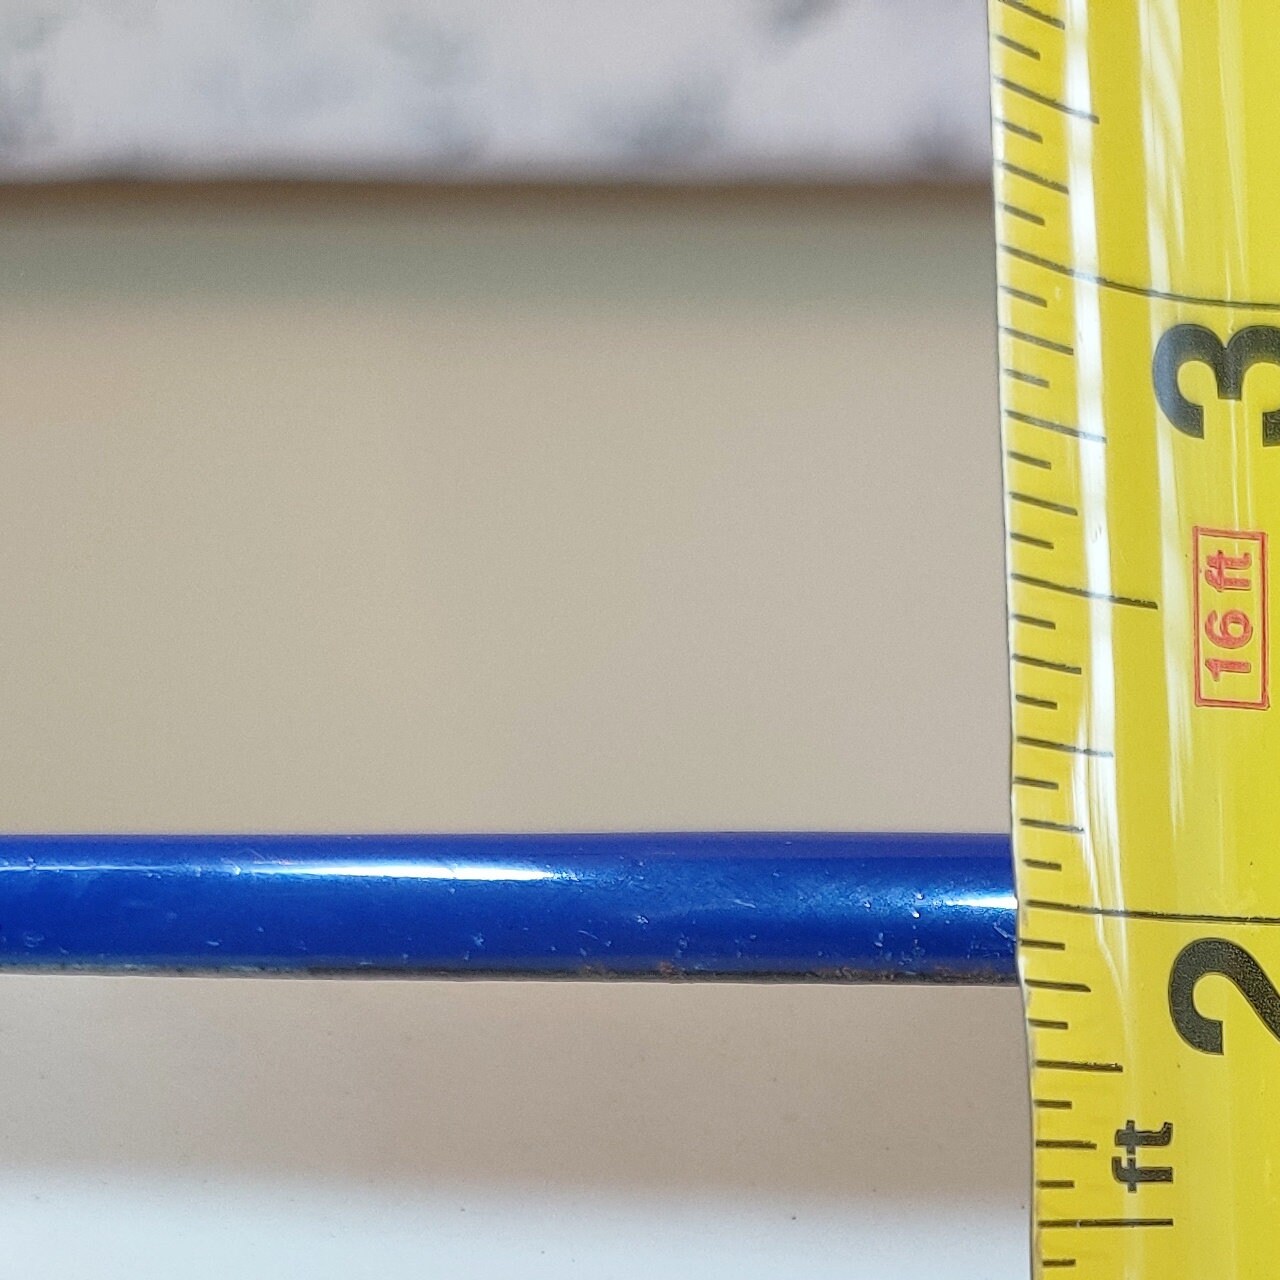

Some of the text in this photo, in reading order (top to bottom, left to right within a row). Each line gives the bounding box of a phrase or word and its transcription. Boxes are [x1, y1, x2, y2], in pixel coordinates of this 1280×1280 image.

[1205, 549, 1253, 681] 16 ft
[1111, 1120, 1174, 1194] ft
